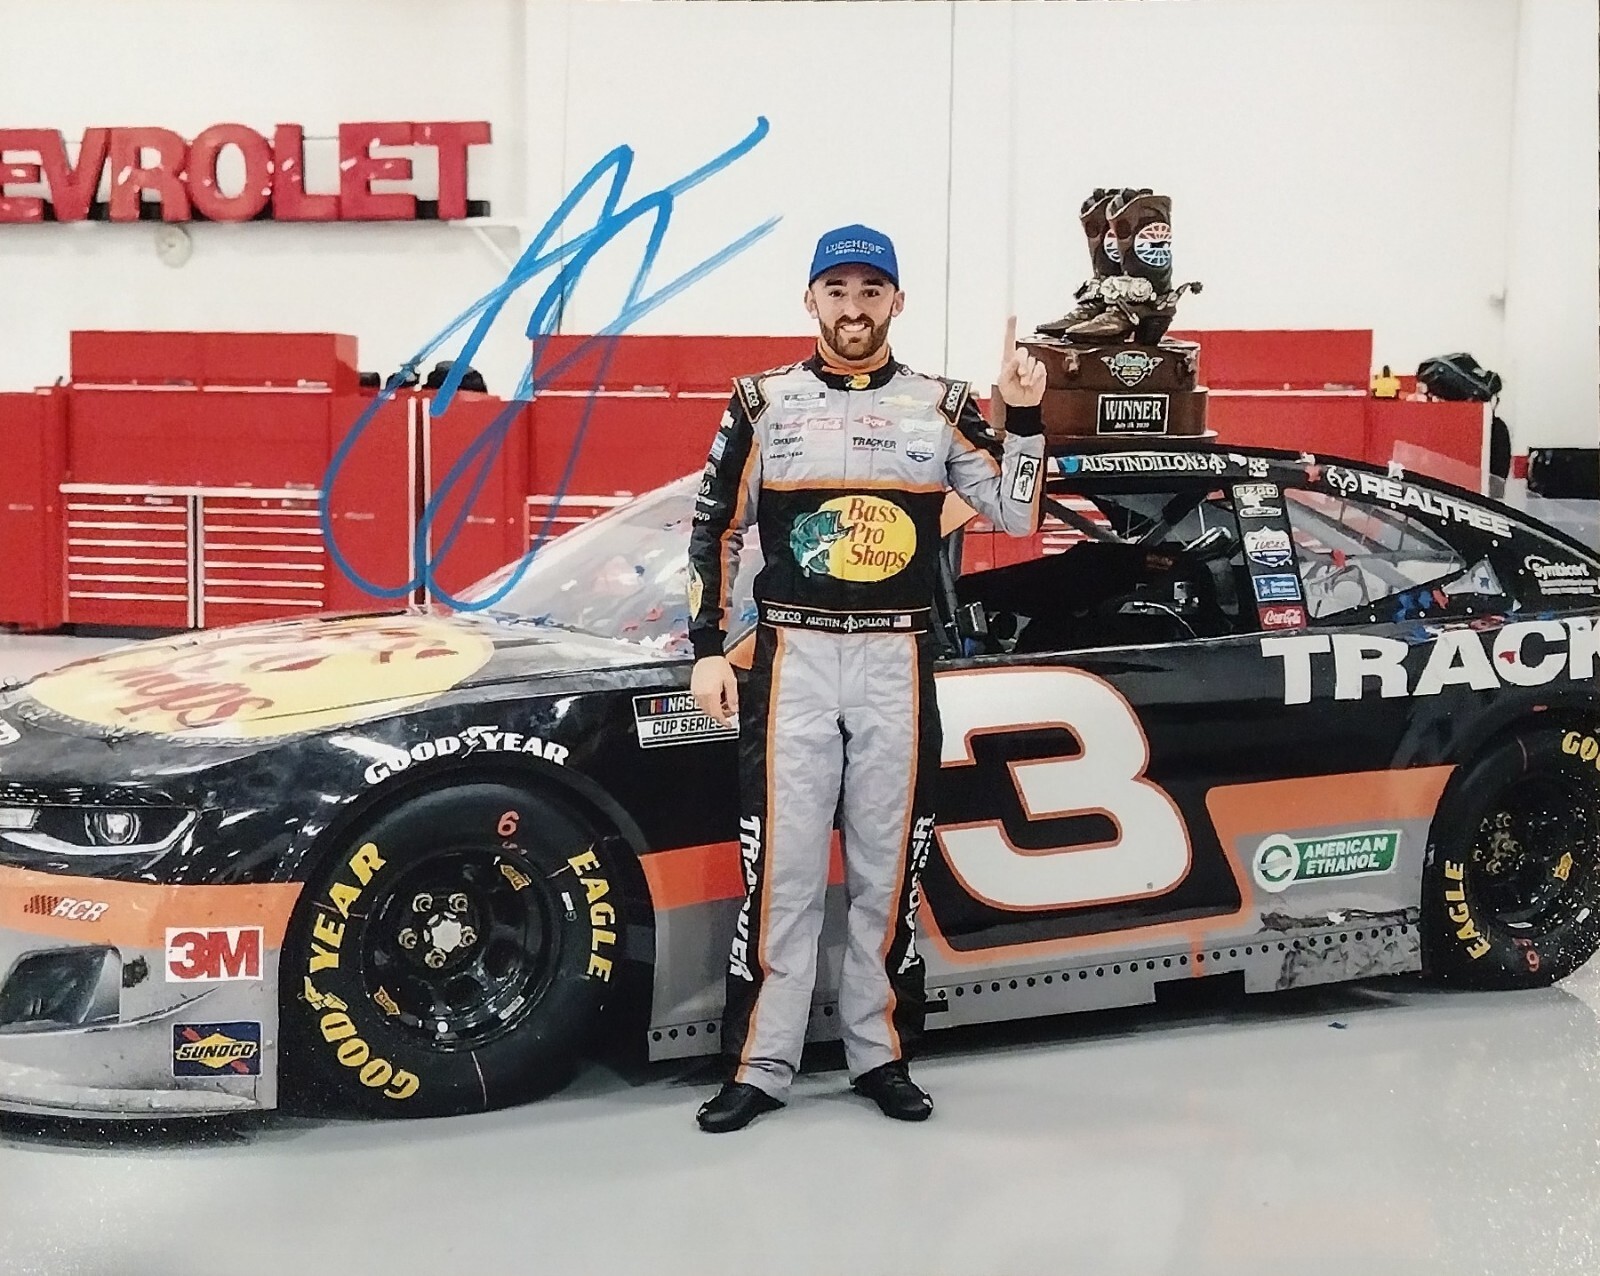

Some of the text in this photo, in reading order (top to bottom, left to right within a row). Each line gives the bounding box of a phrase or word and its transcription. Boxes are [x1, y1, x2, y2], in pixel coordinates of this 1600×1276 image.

[1105, 400, 1162, 420] WINNER
[852, 436, 897, 449] TRACKER
[1082, 454, 1208, 472] AUSTINDILLON3
[847, 498, 898, 523] Bass
[1360, 474, 1513, 538] REALTREE
[849, 522, 885, 544] Pro
[846, 543, 908, 572] Shops
[805, 616, 840, 628] AUSTIN
[858, 616, 890, 627] DILLON
[667, 696, 703, 713] NASC
[652, 720, 678, 735] CUP
[364, 725, 570, 785] GOODYEAR
[1561, 731, 1600, 771] GO
[933, 665, 1193, 912] 3
[497, 810, 519, 836] 6
[1303, 836, 1389, 860] AMERICAN
[1305, 852, 1381, 876] ETHANOL
[50, 897, 109, 922] RCR
[567, 849, 616, 983] EAGLE
[1444, 860, 1491, 959] EAGLE
[169, 931, 260, 979] 3M
[298, 841, 420, 1099] GOODYEAR
[178, 1042, 255, 1061] SUNOCO
